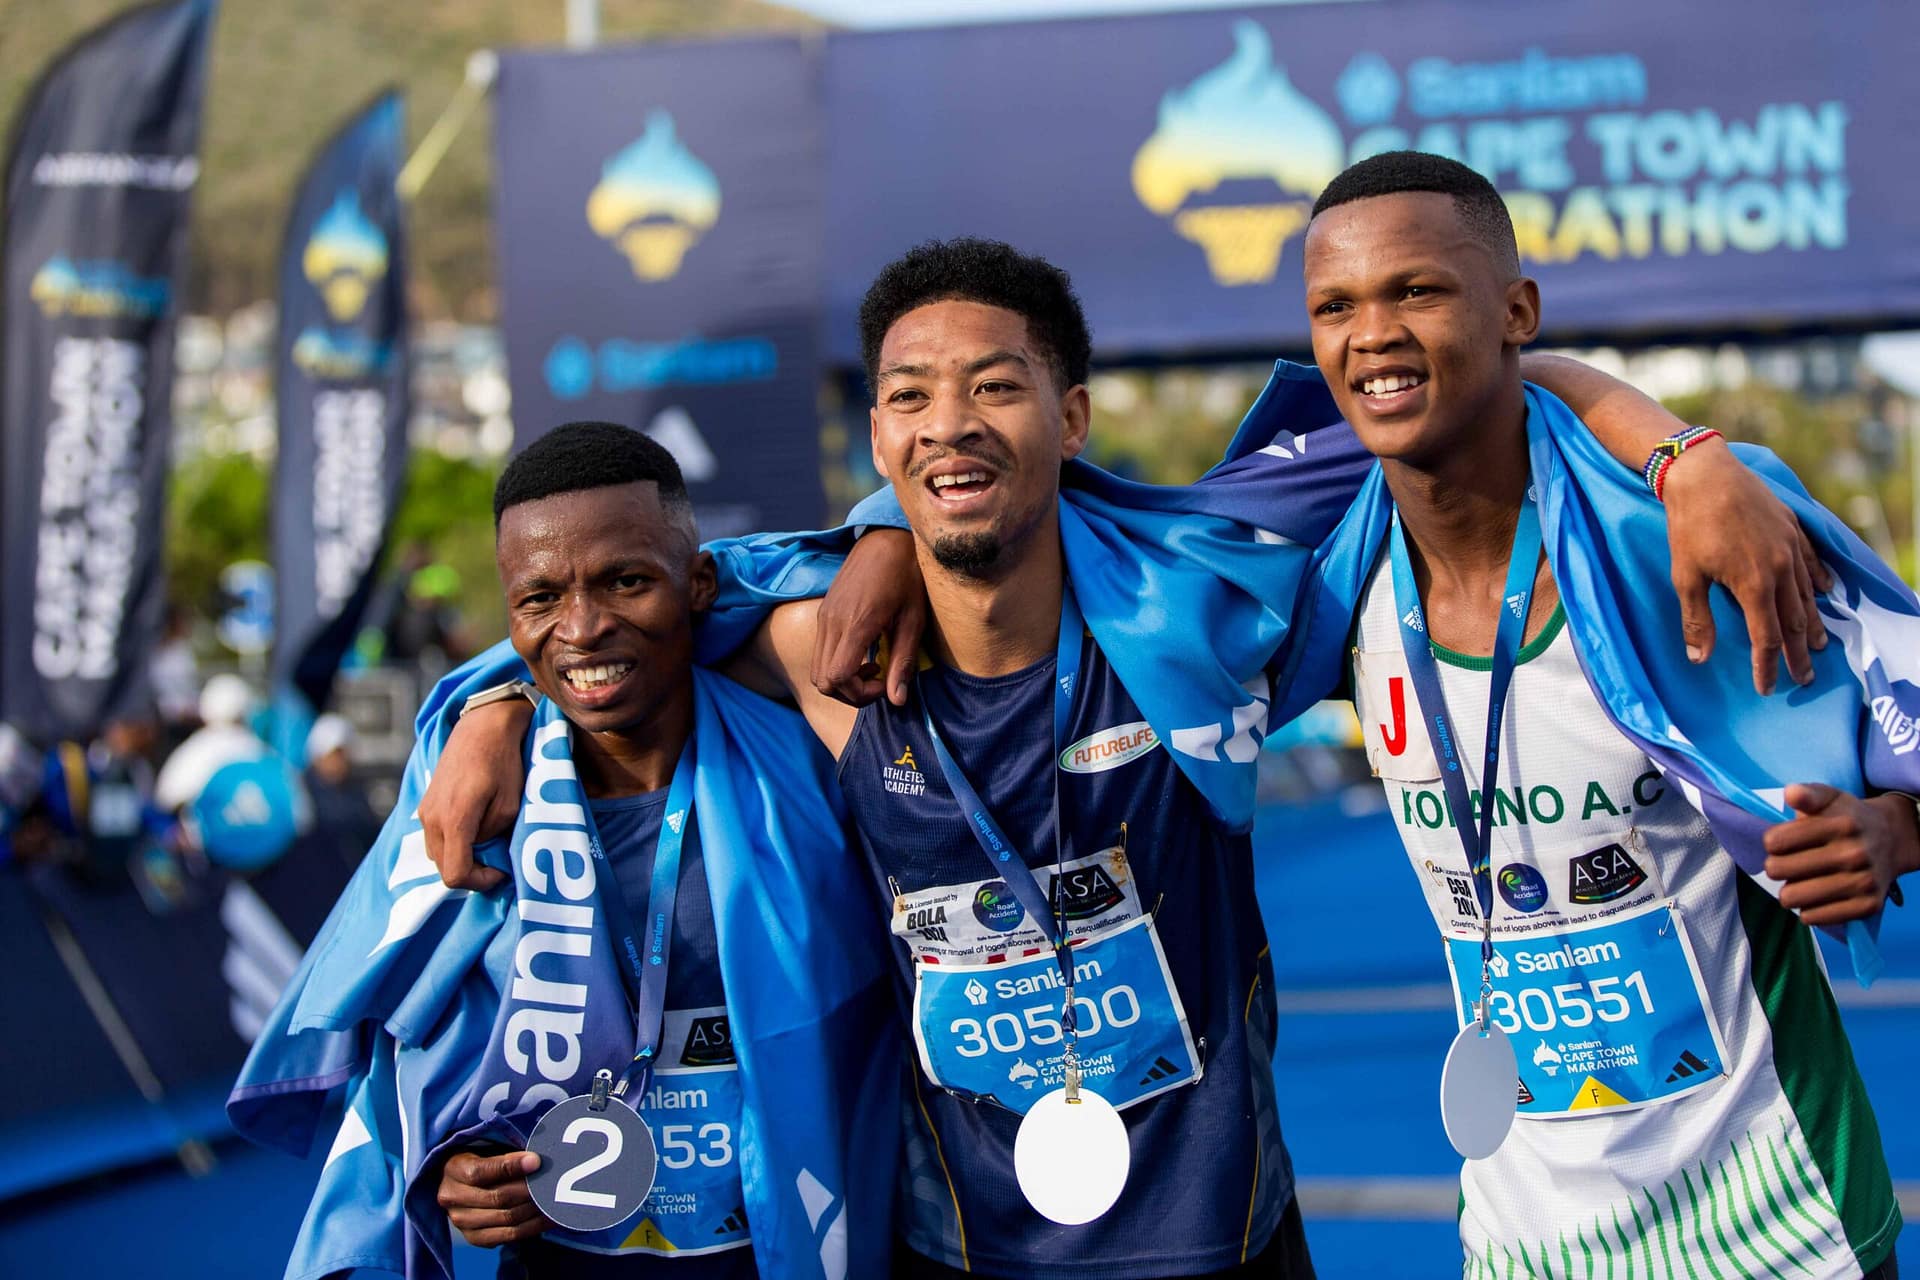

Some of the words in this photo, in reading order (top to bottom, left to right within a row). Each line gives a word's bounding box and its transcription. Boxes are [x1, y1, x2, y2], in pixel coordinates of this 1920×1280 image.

[1407, 46, 1646, 119] Sanlam
[1585, 101, 1848, 185] TOWN
[1503, 175, 1848, 264] RATHON
[1380, 677, 1407, 756] J
[1435, 715, 1454, 759] Sanlam
[883, 766, 925, 784] ATHLETES
[974, 811, 1003, 851] Sanlam
[1575, 849, 1631, 886] ASA
[1055, 870, 1111, 903] ASA
[1520, 884, 1539, 892] Road
[479, 719, 597, 1121] Sanlam
[907, 906, 947, 930] BOLA
[989, 909, 1018, 919] Accident
[996, 902, 1016, 910] Road
[1511, 924, 1531, 932] logos
[1533, 919, 1557, 929] above
[1571, 914, 1588, 924] lead
[1589, 912, 1597, 920] to
[1598, 893, 1656, 917] disqualification
[653, 913, 664, 953] Sanlam
[976, 945, 983, 953] of
[985, 942, 1006, 952] logos
[1008, 939, 1031, 947] above
[1034, 935, 1046, 943] will
[1075, 913, 1131, 935] disqualification
[1515, 941, 1621, 974] Sanlam
[995, 960, 1103, 999] Sanlam
[1489, 970, 1655, 1034] 30551
[691, 1022, 731, 1048] AS
[950, 985, 1141, 1058] 30500
[1047, 1053, 1080, 1065] Sanm
[1563, 1050, 1595, 1063] CAPE
[1596, 1044, 1636, 1058] TOWN
[1567, 1040, 1602, 1051] Sanlam
[1041, 1062, 1071, 1076] CAP
[1077, 1054, 1113, 1068] TOWN
[1043, 1064, 1116, 1086] MATHON
[1566, 1055, 1639, 1074] MARATHON
[641, 1085, 708, 1110] nlam
[1591, 1088, 1599, 1104] F
[555, 1117, 623, 1209] 2
[638, 1203, 696, 1215] ARATHON
[659, 1193, 696, 1204] TOWN
